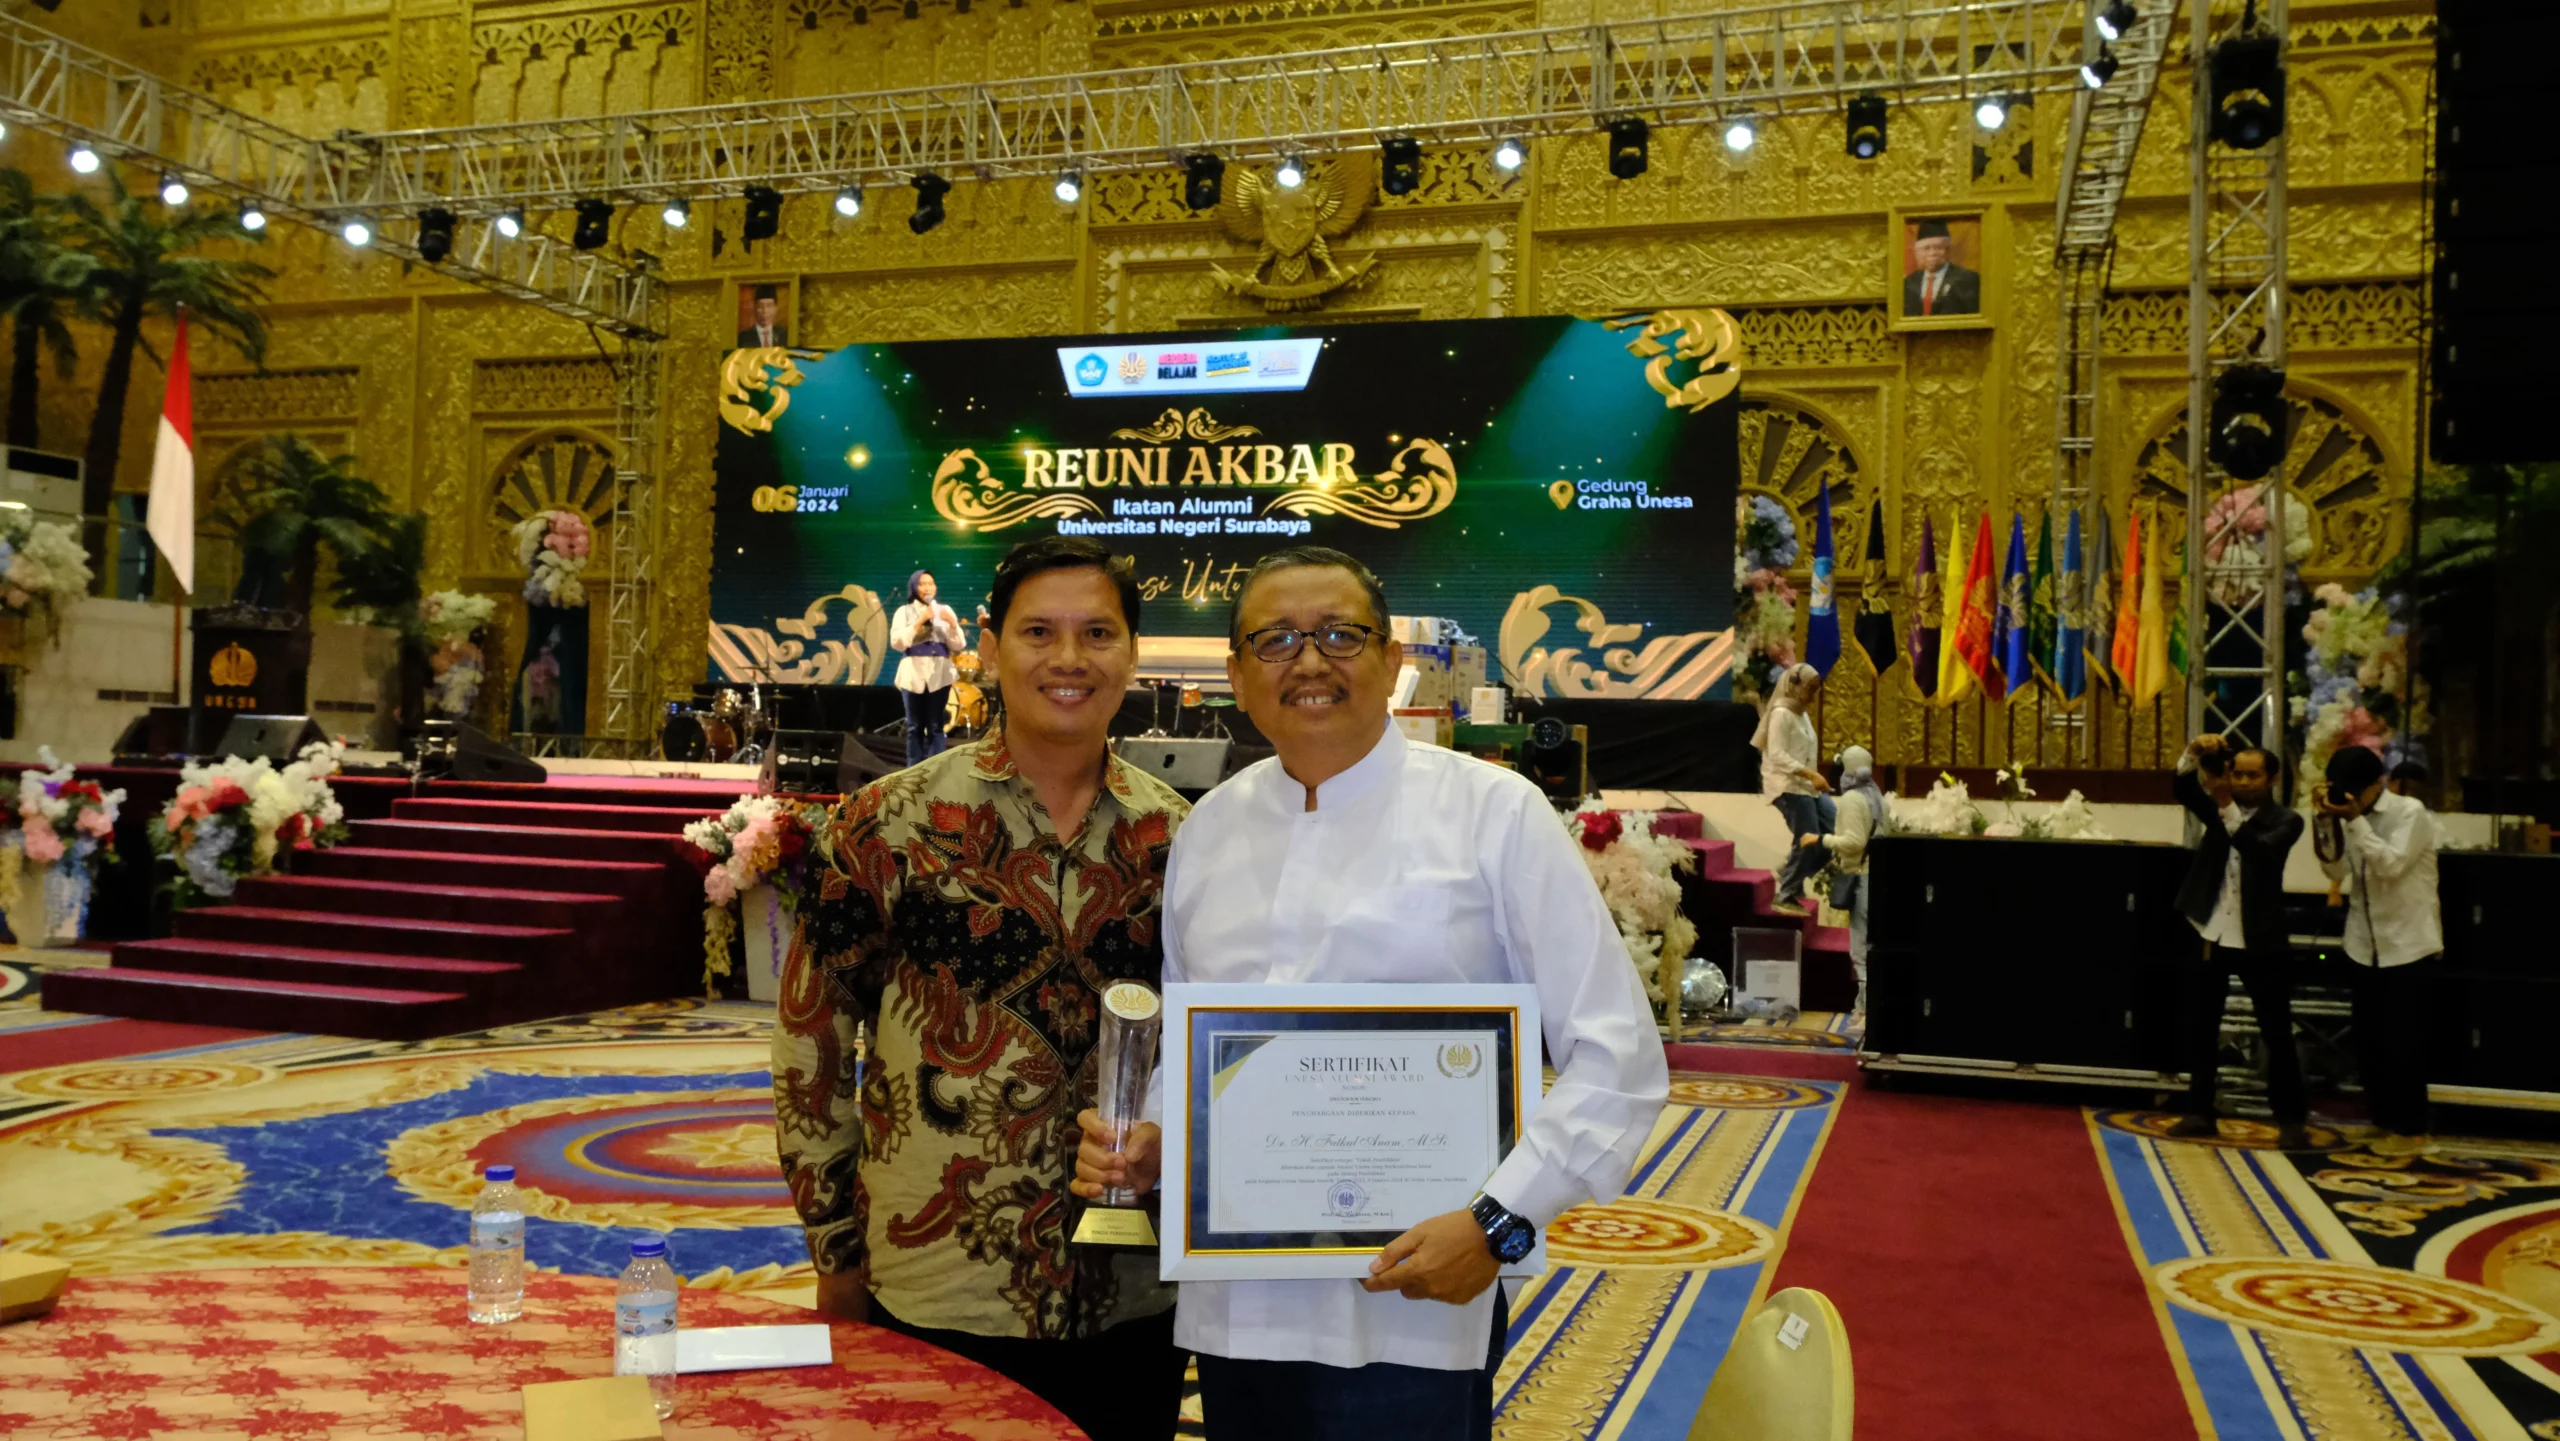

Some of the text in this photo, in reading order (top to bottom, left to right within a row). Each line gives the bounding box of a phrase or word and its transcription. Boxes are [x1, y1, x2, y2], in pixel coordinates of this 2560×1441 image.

[1158, 366, 1197, 379] BELAJAR
[1022, 443, 1359, 489] REUNI AKBAR
[798, 484, 850, 498] Januari
[1577, 478, 1648, 495] Gedung
[752, 485, 798, 512] 06
[796, 499, 839, 512] 2024
[1113, 496, 1253, 516] Ikatan Alumni
[1577, 494, 1694, 509] Graha Unesa
[1057, 517, 1312, 538] Universitas Negeri Surabaya
[1181, 558, 1253, 602] Untu
[1299, 1056, 1410, 1072] SERTIFIKAT
[1284, 1073, 1425, 1084] UNESA ALUMNI AWARD
[1347, 1109, 1386, 1117] DIBERIKAN
[1264, 1133, 1289, 1149] Dr.
